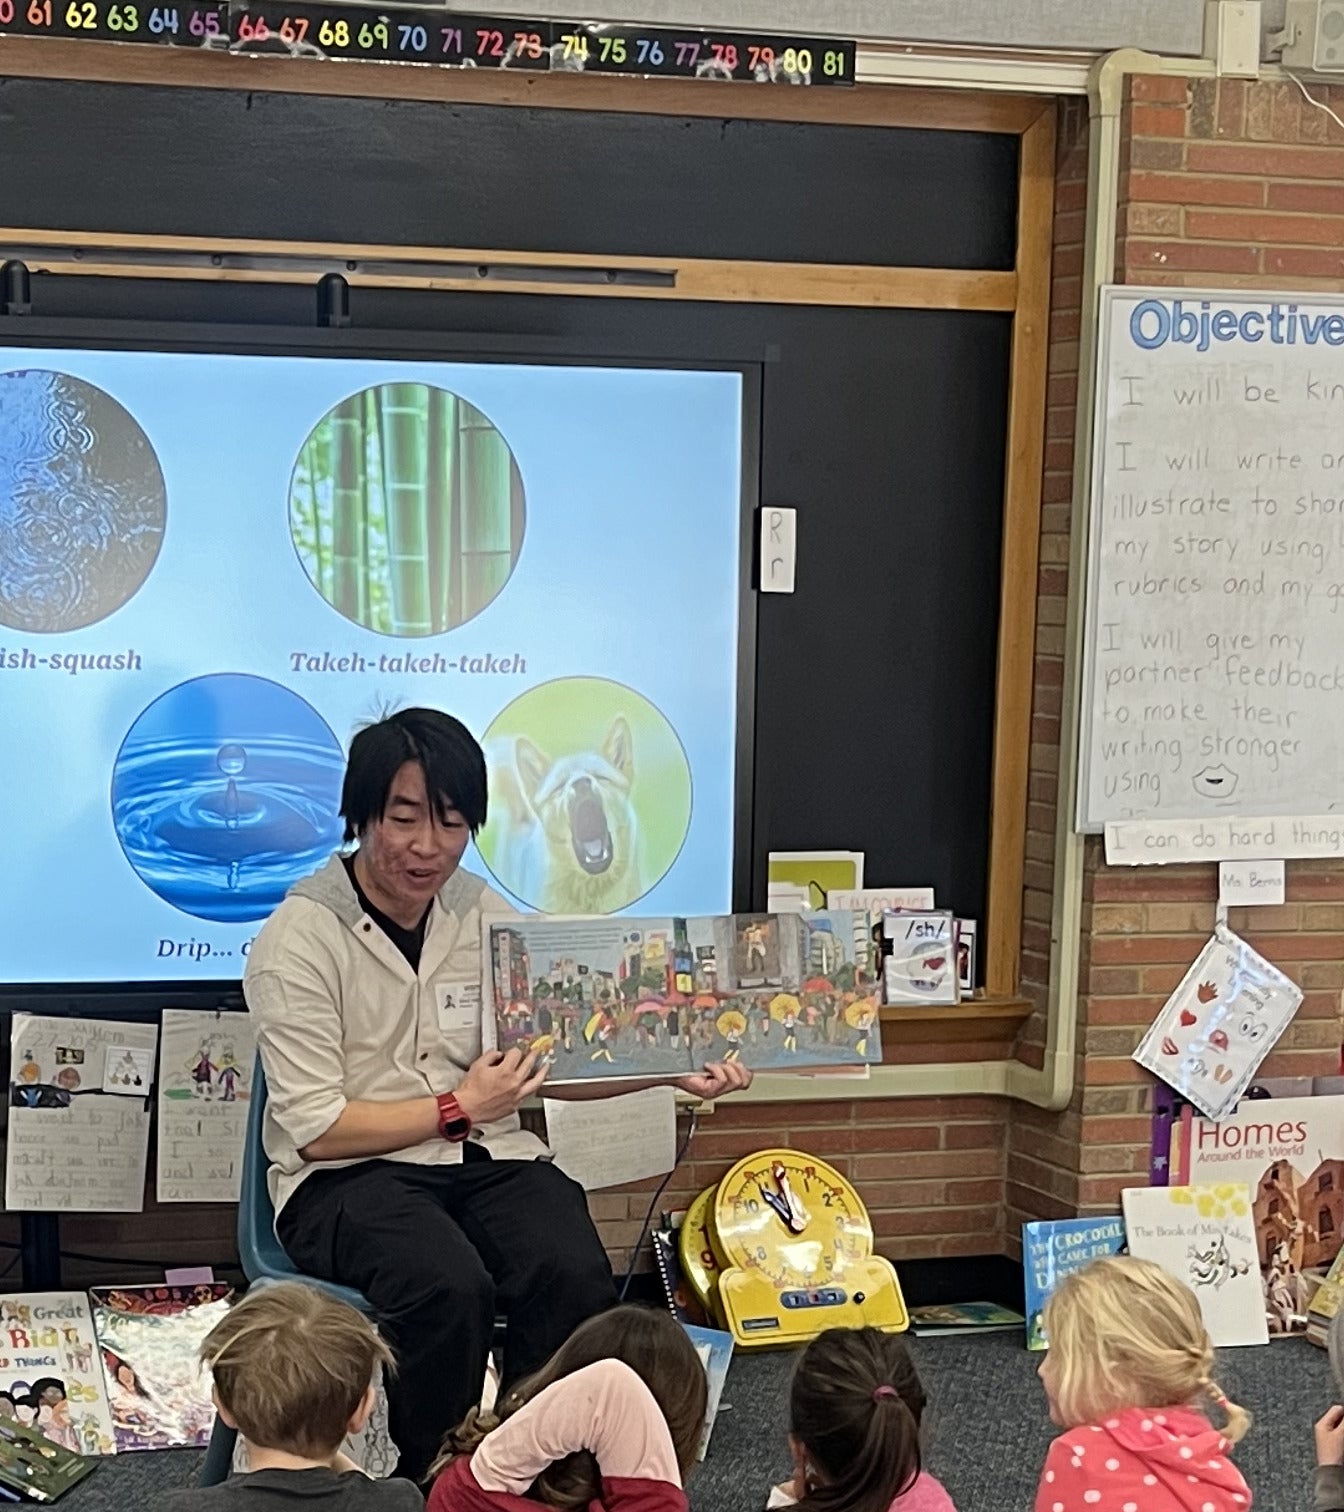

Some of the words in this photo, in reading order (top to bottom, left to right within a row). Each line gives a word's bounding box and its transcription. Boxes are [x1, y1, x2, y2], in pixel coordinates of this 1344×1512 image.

[25, 0, 53, 26] 61
[64, 1, 97, 29] 62
[106, 5, 140, 33] 63
[147, 9, 180, 33] 64
[187, 11, 221, 37] 65
[236, 17, 272, 42] 66
[278, 17, 310, 44] 67
[317, 20, 350, 47] 68
[357, 22, 389, 48] 69
[398, 23, 429, 53] 70
[476, 29, 505, 58] 72
[598, 36, 628, 64] 75
[636, 37, 665, 66] 76
[781, 47, 814, 75] 80
[822, 51, 845, 76] 81
[1121, 376, 1145, 406] I
[1173, 377, 1221, 405] will
[1245, 375, 1280, 402] be
[1115, 442, 1137, 472] I
[1165, 448, 1209, 470] will
[1237, 447, 1302, 470] write
[1112, 489, 1231, 520] illustrate
[1255, 486, 1278, 516] to
[1115, 537, 1149, 562] my
[1173, 532, 1239, 561] story
[1262, 537, 1325, 574] using
[1113, 570, 1201, 597] rubrics
[1223, 570, 1264, 596] and
[1282, 575, 1314, 598] my
[1102, 622, 1121, 652] I
[1141, 630, 1181, 650] will
[1205, 632, 1255, 661] give
[1269, 636, 1305, 660] my
[290, 652, 527, 675] Takeh-takeh-takeh
[1105, 663, 1205, 692] partner
[1103, 699, 1129, 725] to
[1144, 697, 1208, 722] make
[1231, 698, 1298, 729] their
[1102, 731, 1183, 773] writing
[1201, 732, 1302, 772] stronger
[1105, 770, 1162, 807] using
[1111, 825, 1129, 851] I
[1145, 834, 1179, 850] can
[1192, 824, 1216, 850] do
[1230, 823, 1276, 847] hard
[904, 920, 946, 941] /sh/
[1198, 1120, 1308, 1149] Homes
[1197, 1147, 1242, 1163] Around
[1245, 1148, 1265, 1160] the
[1269, 1144, 1305, 1158] World
[1132, 1225, 1154, 1238] The
[1156, 1225, 1186, 1238] Book
[1187, 1223, 1198, 1237] of
